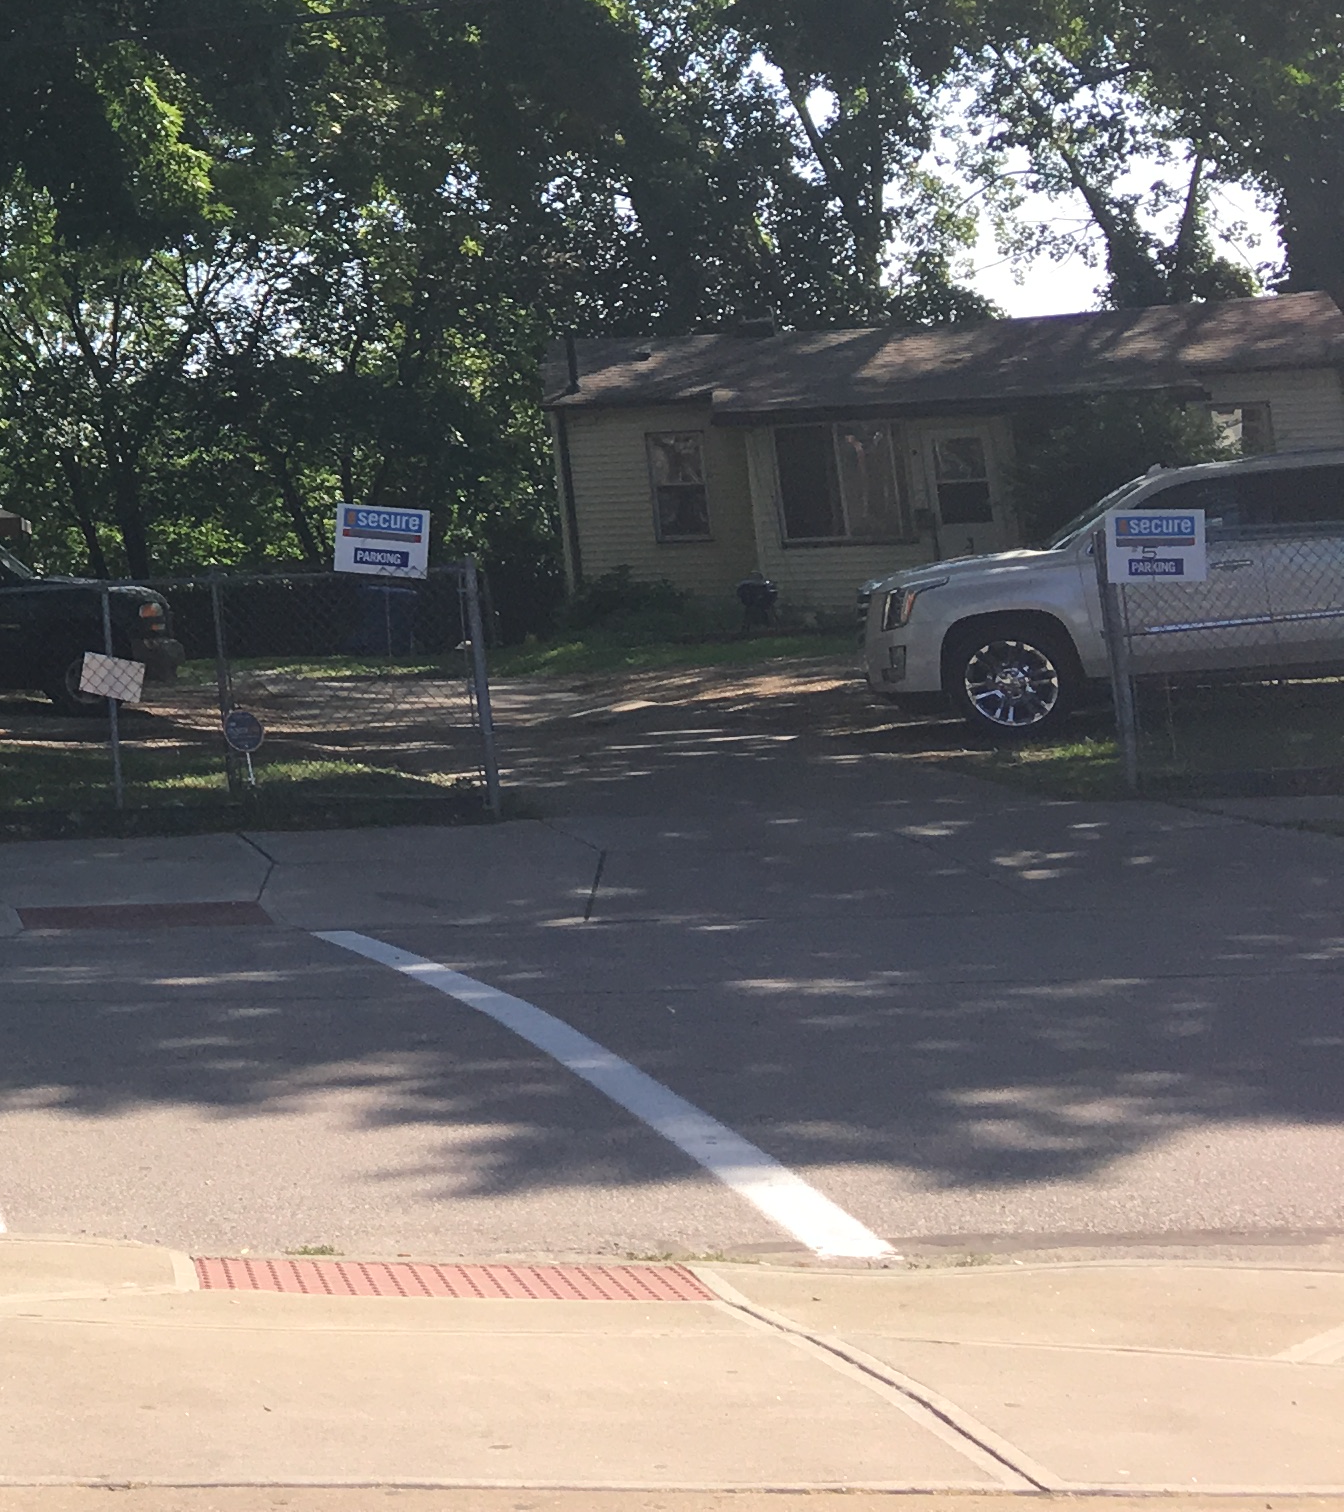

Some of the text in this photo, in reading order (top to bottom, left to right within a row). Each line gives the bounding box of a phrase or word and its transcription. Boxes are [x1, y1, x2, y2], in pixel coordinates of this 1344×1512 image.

[358, 511, 420, 530] secure
[1129, 518, 1192, 534] secure
[356, 550, 402, 565] PARKING
[1131, 561, 1176, 573] PARKING
